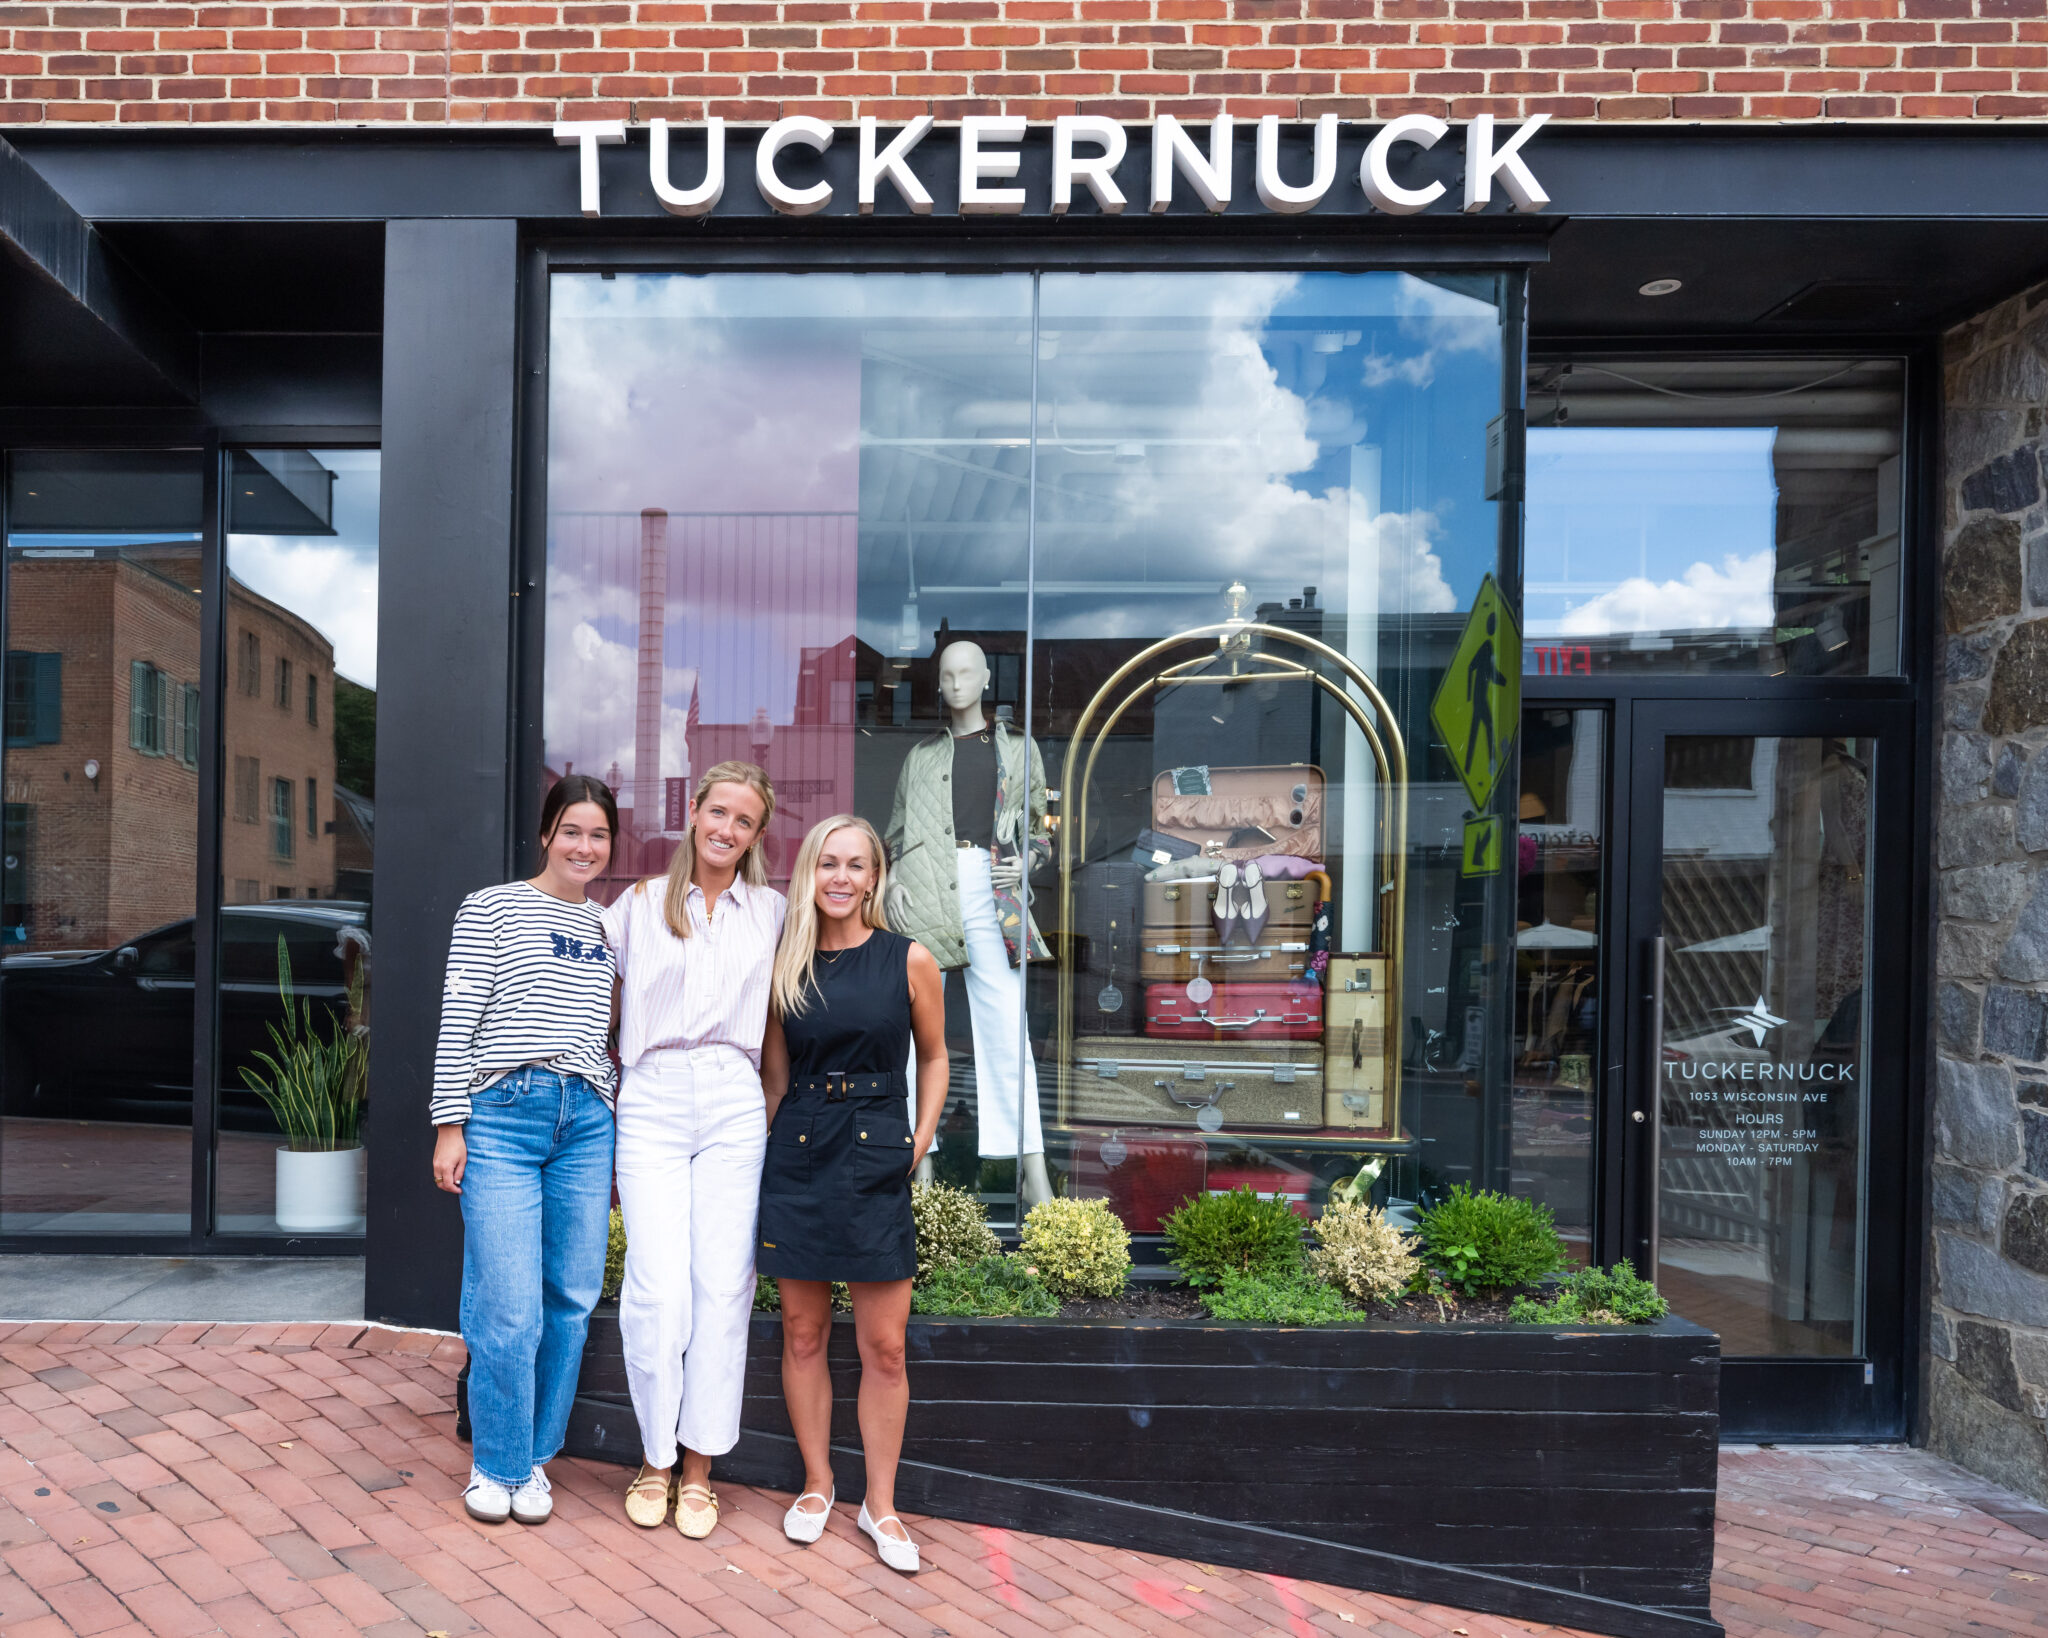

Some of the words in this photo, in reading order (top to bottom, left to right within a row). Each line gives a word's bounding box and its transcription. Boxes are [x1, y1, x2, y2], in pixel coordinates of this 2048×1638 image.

[552, 112, 1553, 215] TUCKERNUCK
[1664, 1062, 1855, 1081] TUCKERNUCK
[1689, 1092, 1718, 1102] 1053
[1724, 1092, 1797, 1102] WISCONSIN
[1803, 1093, 1828, 1102] AVE
[1735, 1113, 1784, 1124] HOURS
[1699, 1130, 1745, 1139] SUNDAY
[1751, 1130, 1780, 1139] 12PM
[1792, 1130, 1816, 1139] 5PM
[1696, 1143, 1746, 1153] MONDAY
[1758, 1143, 1819, 1153] SATURDAY
[1727, 1157, 1756, 1166] 10AM
[1769, 1157, 1792, 1166] 7PM
